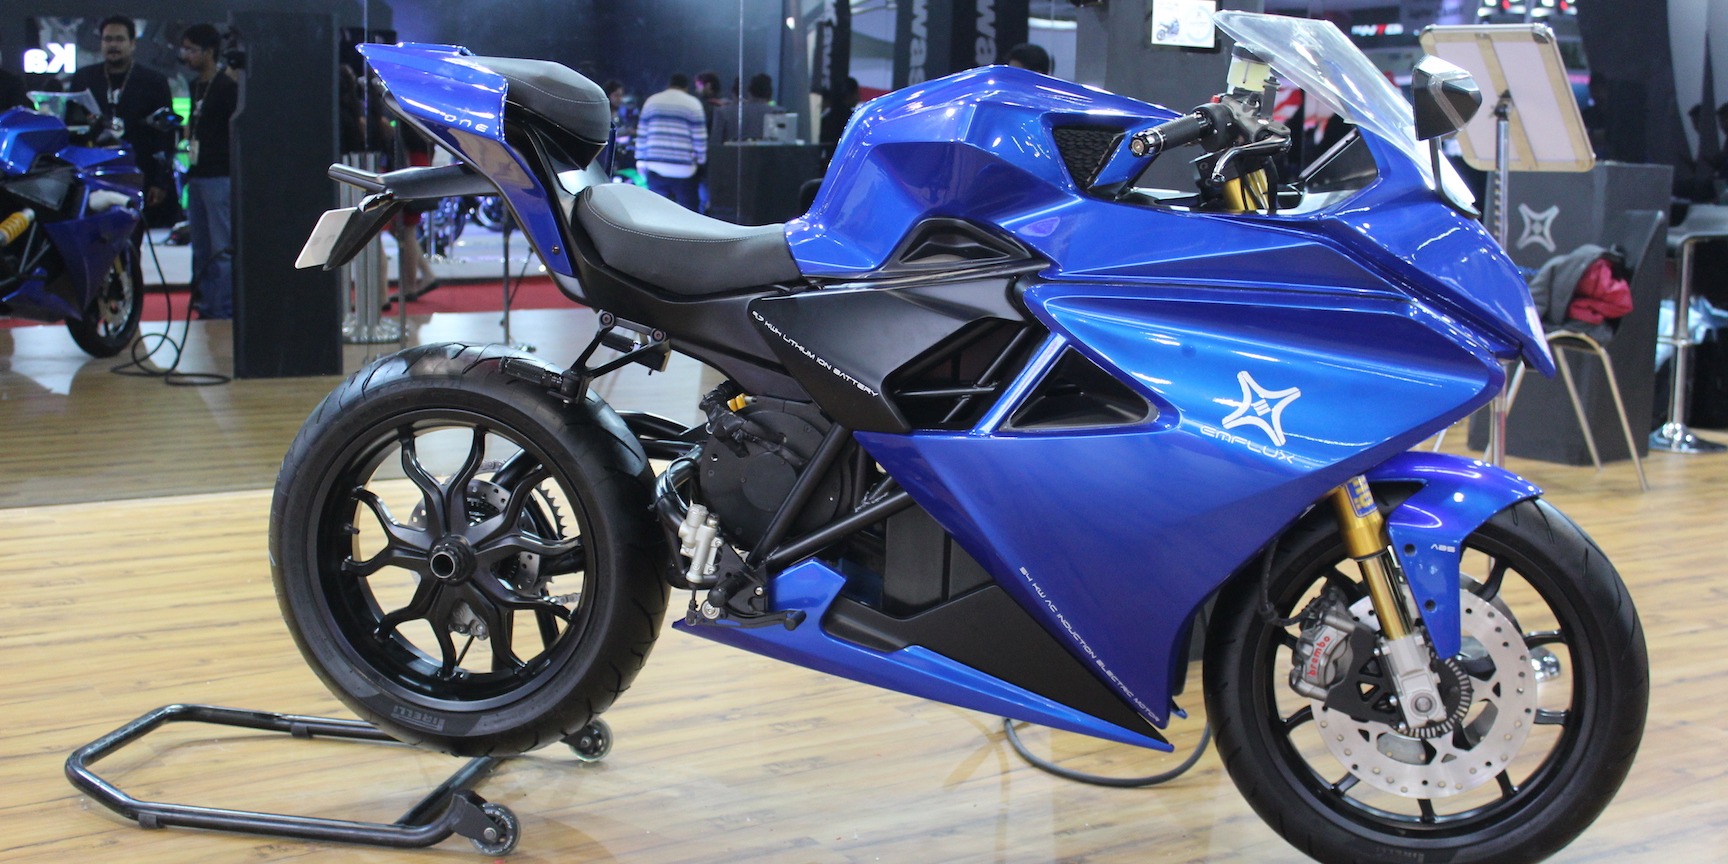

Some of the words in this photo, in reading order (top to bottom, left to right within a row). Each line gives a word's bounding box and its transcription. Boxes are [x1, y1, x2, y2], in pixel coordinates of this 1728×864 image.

[782, 334, 816, 360] LITHIUM
[816, 357, 832, 370] ION
[833, 367, 879, 397] BATTERY
[1200, 425, 1295, 464] EMFLUX
[1032, 583, 1046, 598] KW
[1045, 599, 1059, 613] AC
[1056, 613, 1097, 659] INDUCTION
[1096, 659, 1135, 698] ELECTRIC
[1133, 698, 1160, 722] MOTOR
[1307, 636, 1331, 677] brembo
[391, 704, 446, 732] PIRELLI
